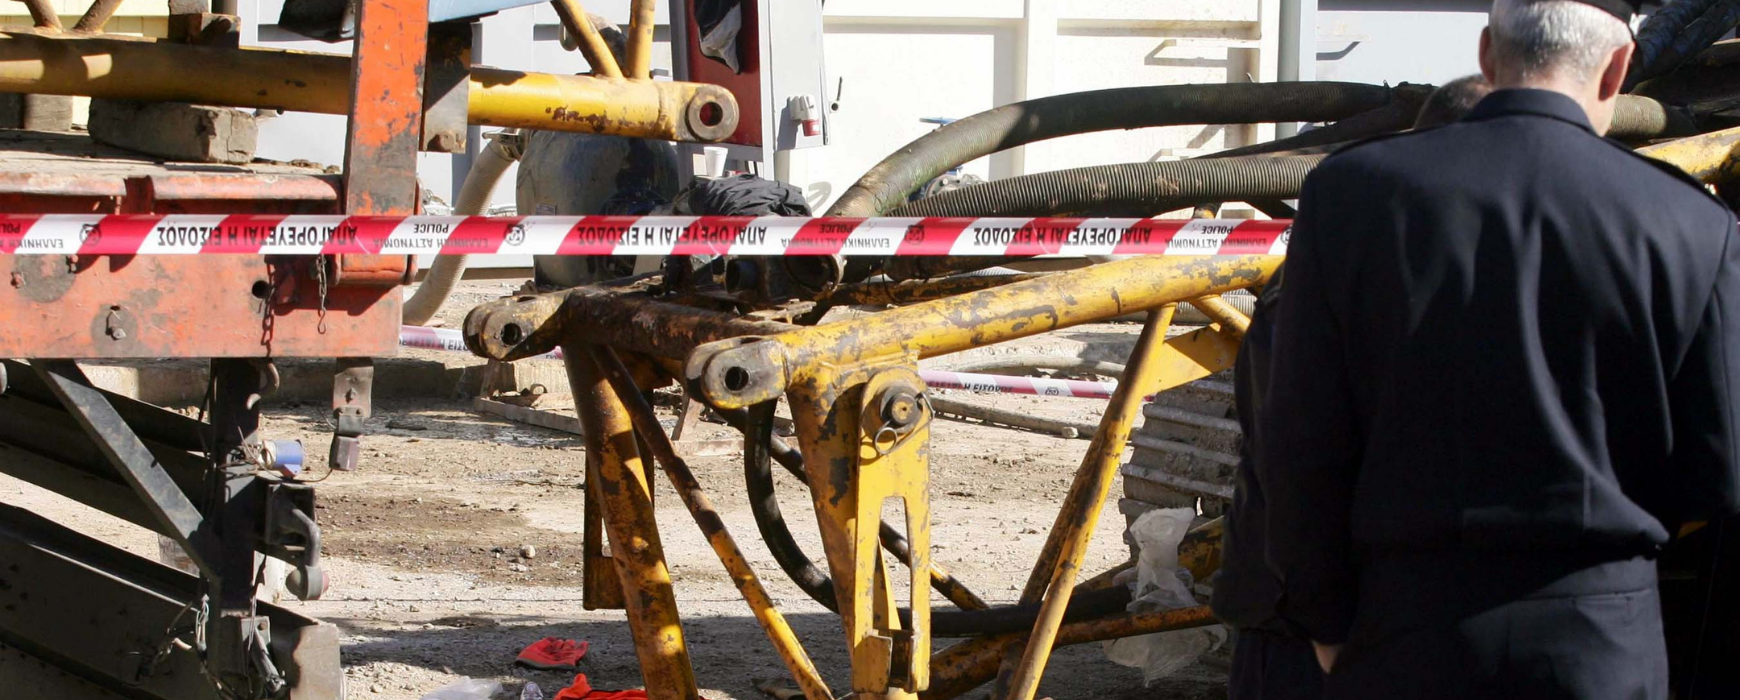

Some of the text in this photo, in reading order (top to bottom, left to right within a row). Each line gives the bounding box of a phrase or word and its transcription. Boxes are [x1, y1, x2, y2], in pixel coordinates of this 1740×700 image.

[414, 223, 449, 233] POLICE
[819, 223, 853, 233] POLICE
[1201, 225, 1234, 234] POLICE
[157, 226, 358, 246] ΑΠΑΓΟΡΕΥΕΤΑΙ Η ΕΙΣΟΔΟΣ
[577, 226, 767, 246] ΑΠΑΓΟΡΕΥΕΤΑΙ Η ΕΙΣΟΔΟΣ
[973, 227, 1152, 246] ΑΠΑΓΟΡΕΥΕΤΑΙ Η ΕΙΣΟΔΟΣ
